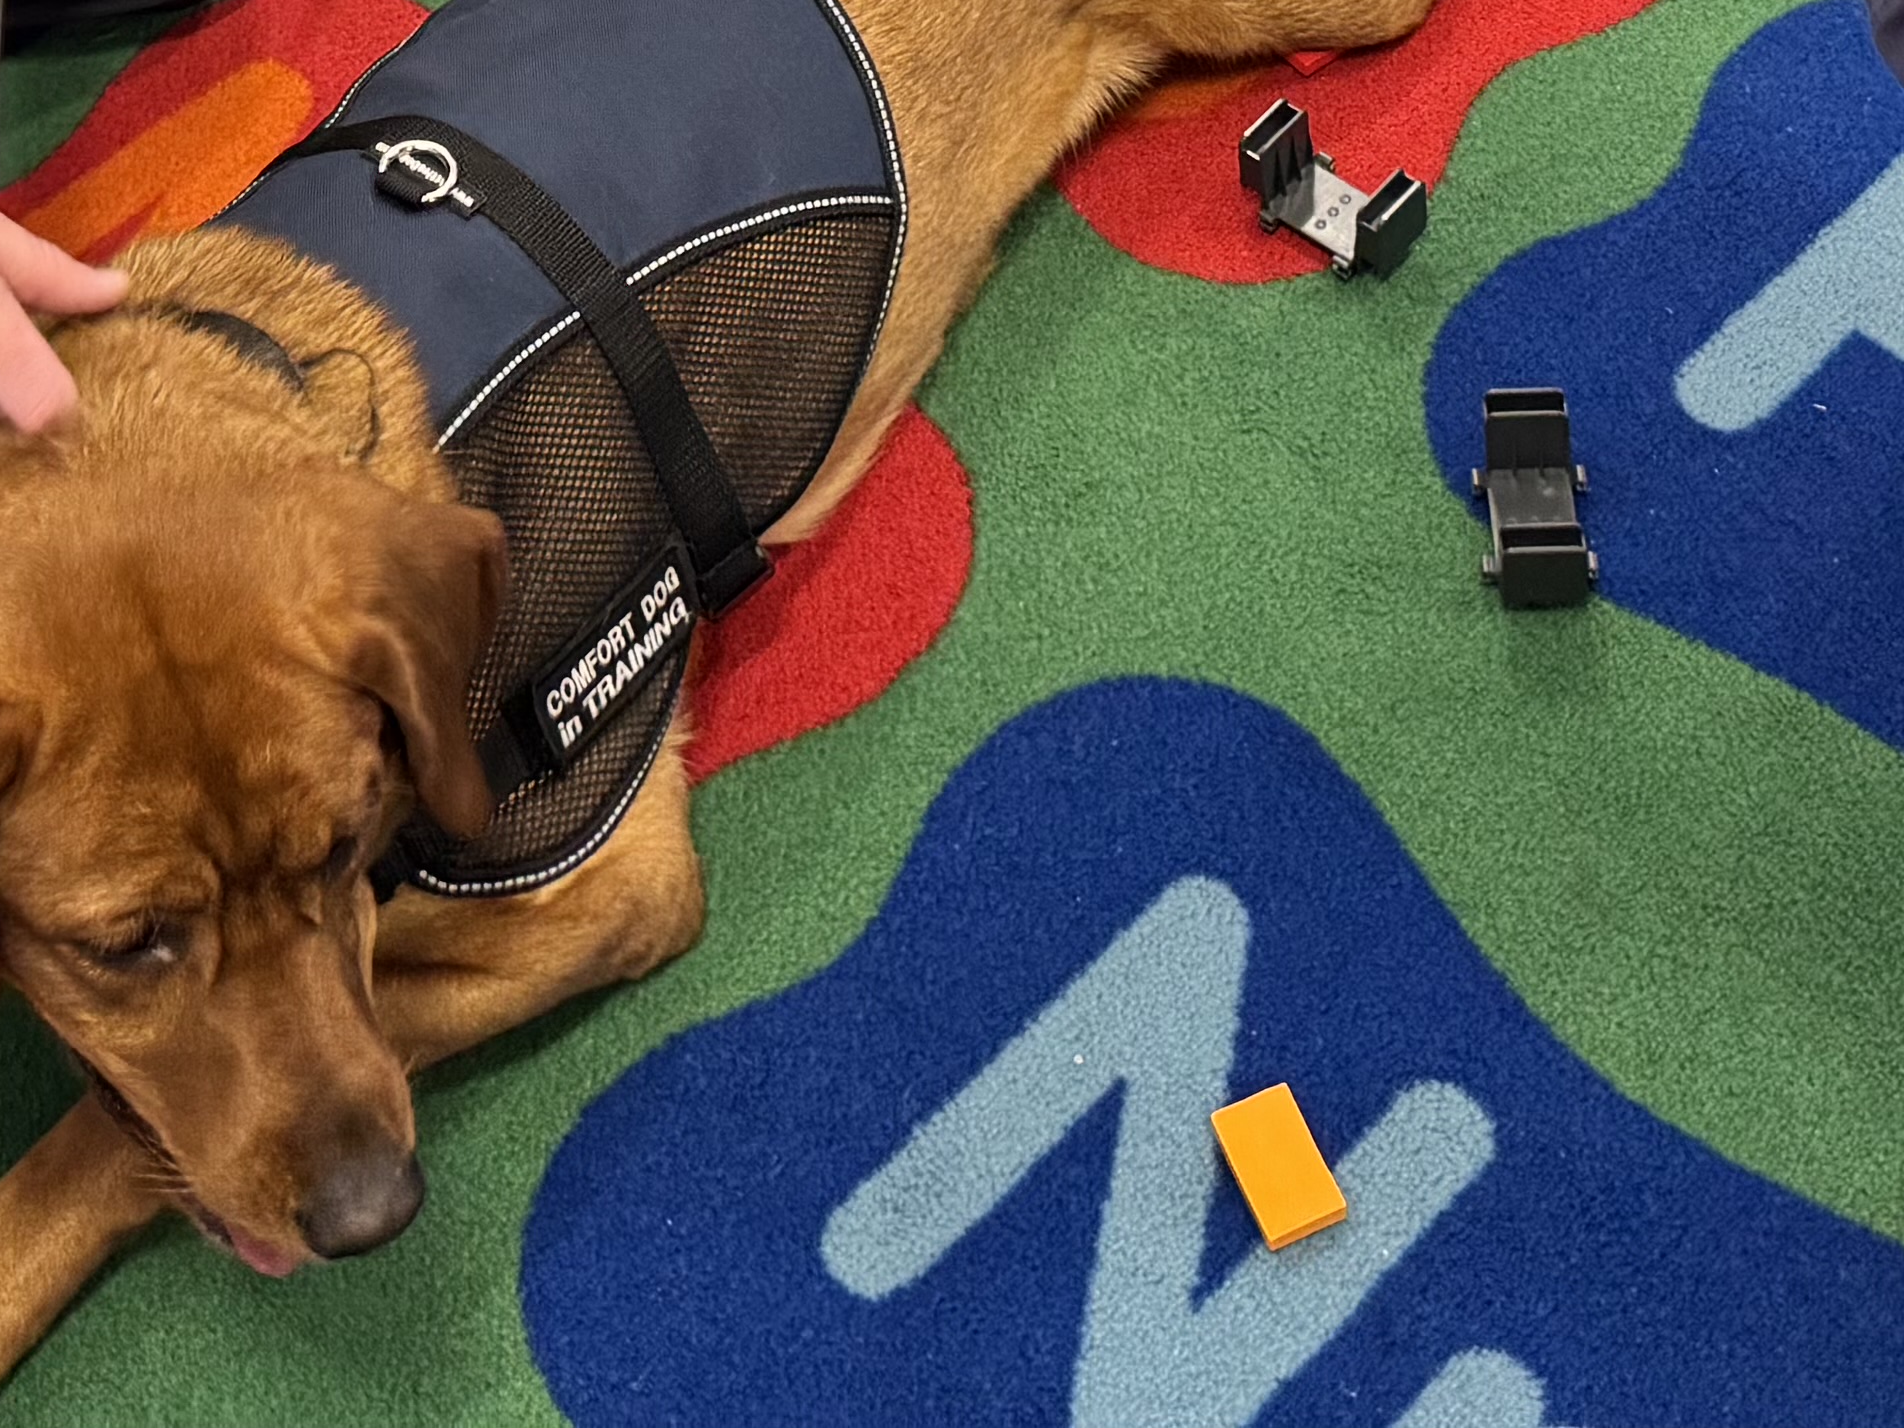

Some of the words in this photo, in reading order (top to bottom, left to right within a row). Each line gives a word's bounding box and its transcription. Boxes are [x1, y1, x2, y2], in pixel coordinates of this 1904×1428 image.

[545, 613, 637, 719] COMFORT
[639, 566, 681, 624] DOG
[557, 712, 584, 749] in
[582, 596, 692, 719] TRAINING
